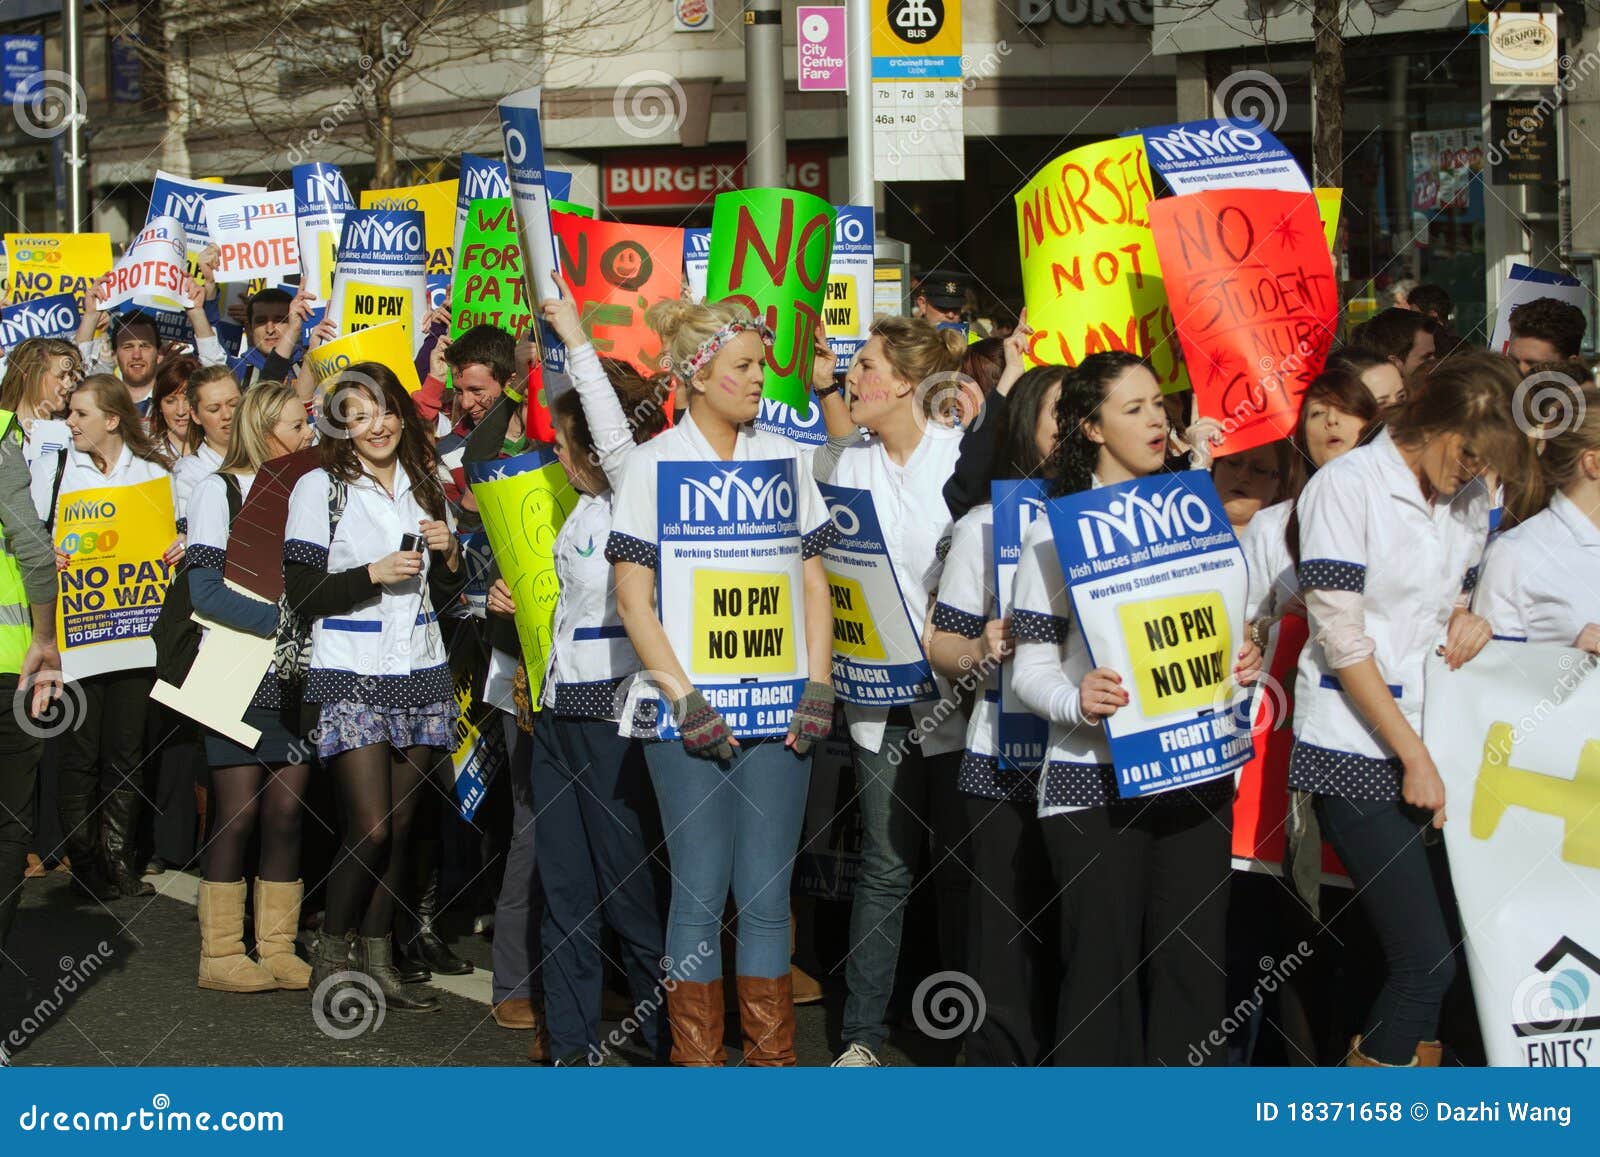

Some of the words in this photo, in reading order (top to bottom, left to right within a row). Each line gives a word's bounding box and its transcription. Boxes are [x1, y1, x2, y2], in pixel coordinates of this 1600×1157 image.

[906, 29, 926, 38] BUS
[802, 44, 827, 57] City
[802, 56, 843, 68] Centre
[924, 59, 945, 67] Street
[802, 68, 830, 80] Fare
[879, 90, 890, 98] 7b
[901, 90, 914, 99] 7d
[875, 115, 895, 124] 46a
[901, 115, 917, 123] 140
[1147, 127, 1262, 161] INMO
[611, 164, 734, 193] BURGER
[1178, 174, 1208, 184] Working
[242, 201, 289, 231] pna
[129, 227, 168, 256] pna
[346, 214, 421, 251] INMO
[1174, 206, 1255, 270] NO
[372, 252, 404, 261] Midwives
[462, 243, 520, 271] FOR
[728, 198, 832, 294] NO
[15, 271, 53, 292] NO
[105, 260, 188, 299] PROTEST
[1051, 243, 1142, 298] NOT
[826, 282, 849, 300] PAY
[1185, 265, 1330, 333] STUDENT
[355, 294, 374, 315] NO
[378, 296, 403, 316] PAY
[155, 311, 185, 326] FIGHT
[824, 308, 851, 326] WAY
[680, 467, 793, 521] INMO
[64, 501, 116, 522] INMO
[1077, 486, 1212, 559] INMO
[663, 523, 681, 535] Irish
[683, 524, 715, 535] Nurses
[718, 523, 735, 535] and
[737, 521, 777, 535] Midwives
[65, 536, 113, 552] USI
[674, 548, 712, 559] Working
[714, 548, 749, 558] Student
[1000, 545, 1021, 559] Irish
[1069, 564, 1092, 580] Irish
[1092, 552, 1131, 574] Nurses
[1131, 548, 1150, 564] and
[1149, 539, 1193, 559] Midwives
[1191, 532, 1234, 551] Organisation
[61, 568, 109, 593] NO
[118, 558, 171, 585] PAY
[1089, 582, 1133, 601] Working
[1133, 573, 1172, 591] Student
[1172, 557, 1235, 581] Nurses/Midwives
[63, 590, 106, 614] NO
[713, 588, 742, 617] NO
[747, 586, 780, 616] PAY
[67, 625, 83, 633] WED
[84, 622, 97, 631] FEB
[118, 616, 148, 625] PROTEST
[110, 609, 144, 619] LUNCHTIME
[68, 632, 83, 643] TO
[84, 627, 114, 641] DEPT.
[115, 624, 131, 635] OF
[1144, 615, 1180, 652] NO
[1179, 606, 1217, 643] PAY
[709, 630, 738, 659] NO
[743, 628, 784, 658] WAY
[846, 666, 890, 684] BACK!
[1151, 661, 1187, 699] NO
[702, 689, 750, 708] FIGHT
[751, 685, 793, 706] BACK!
[856, 682, 934, 699] CAMPAIGN
[1158, 721, 1212, 753] FIGHT
[1004, 743, 1043, 758] JOIN
[1122, 761, 1163, 785] JOIN
[1170, 747, 1218, 774] INMO
